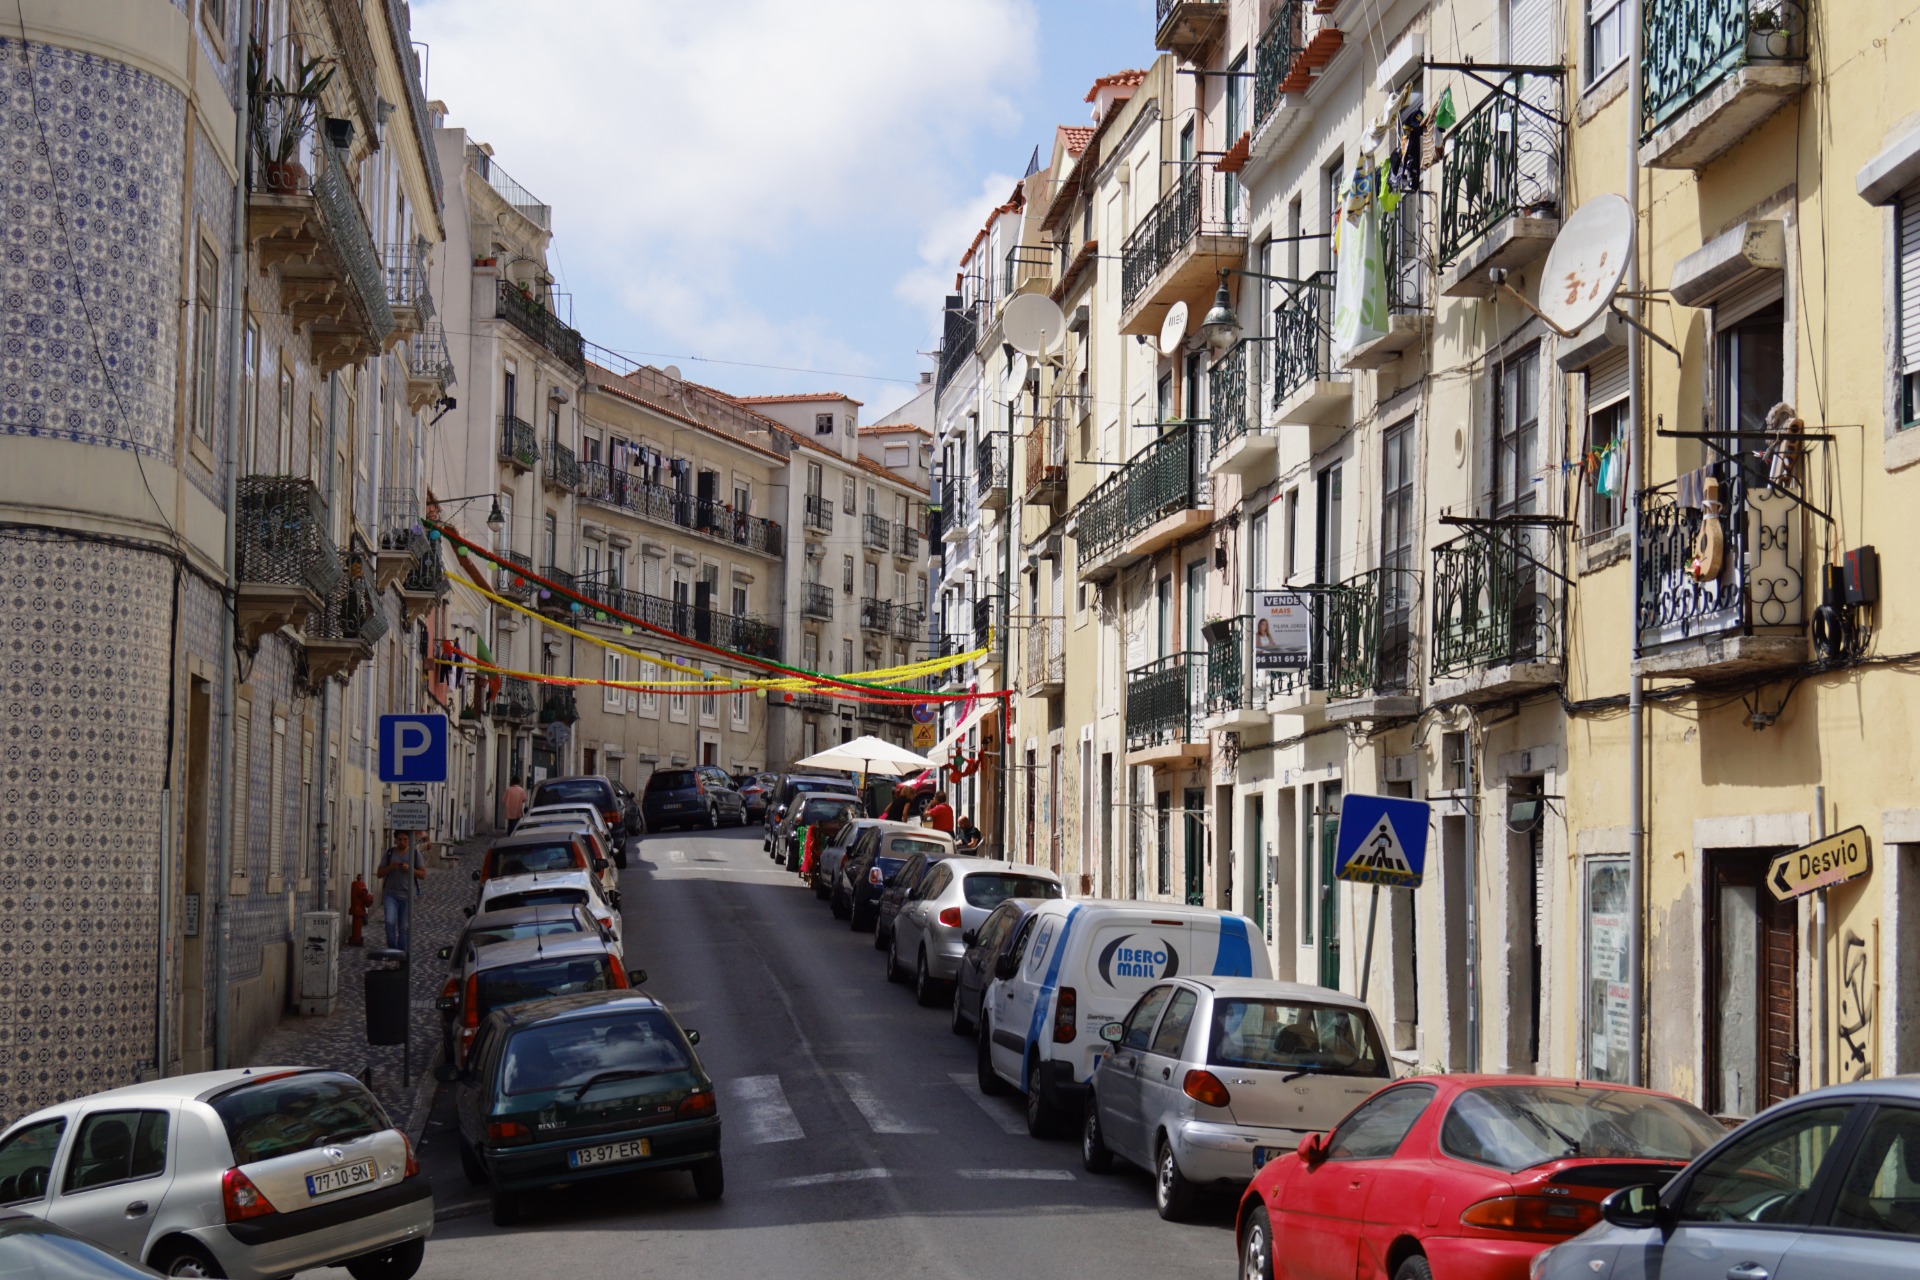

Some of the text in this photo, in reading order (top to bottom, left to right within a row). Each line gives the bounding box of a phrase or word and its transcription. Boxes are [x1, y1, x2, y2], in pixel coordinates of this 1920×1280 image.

[1168, 312, 1184, 327] MEO
[1265, 596, 1300, 606] VENDE
[394, 721, 432, 776] P
[1799, 840, 1858, 880] Desvio
[1117, 948, 1167, 965] IBERO
[1117, 962, 1155, 978] MAIL
